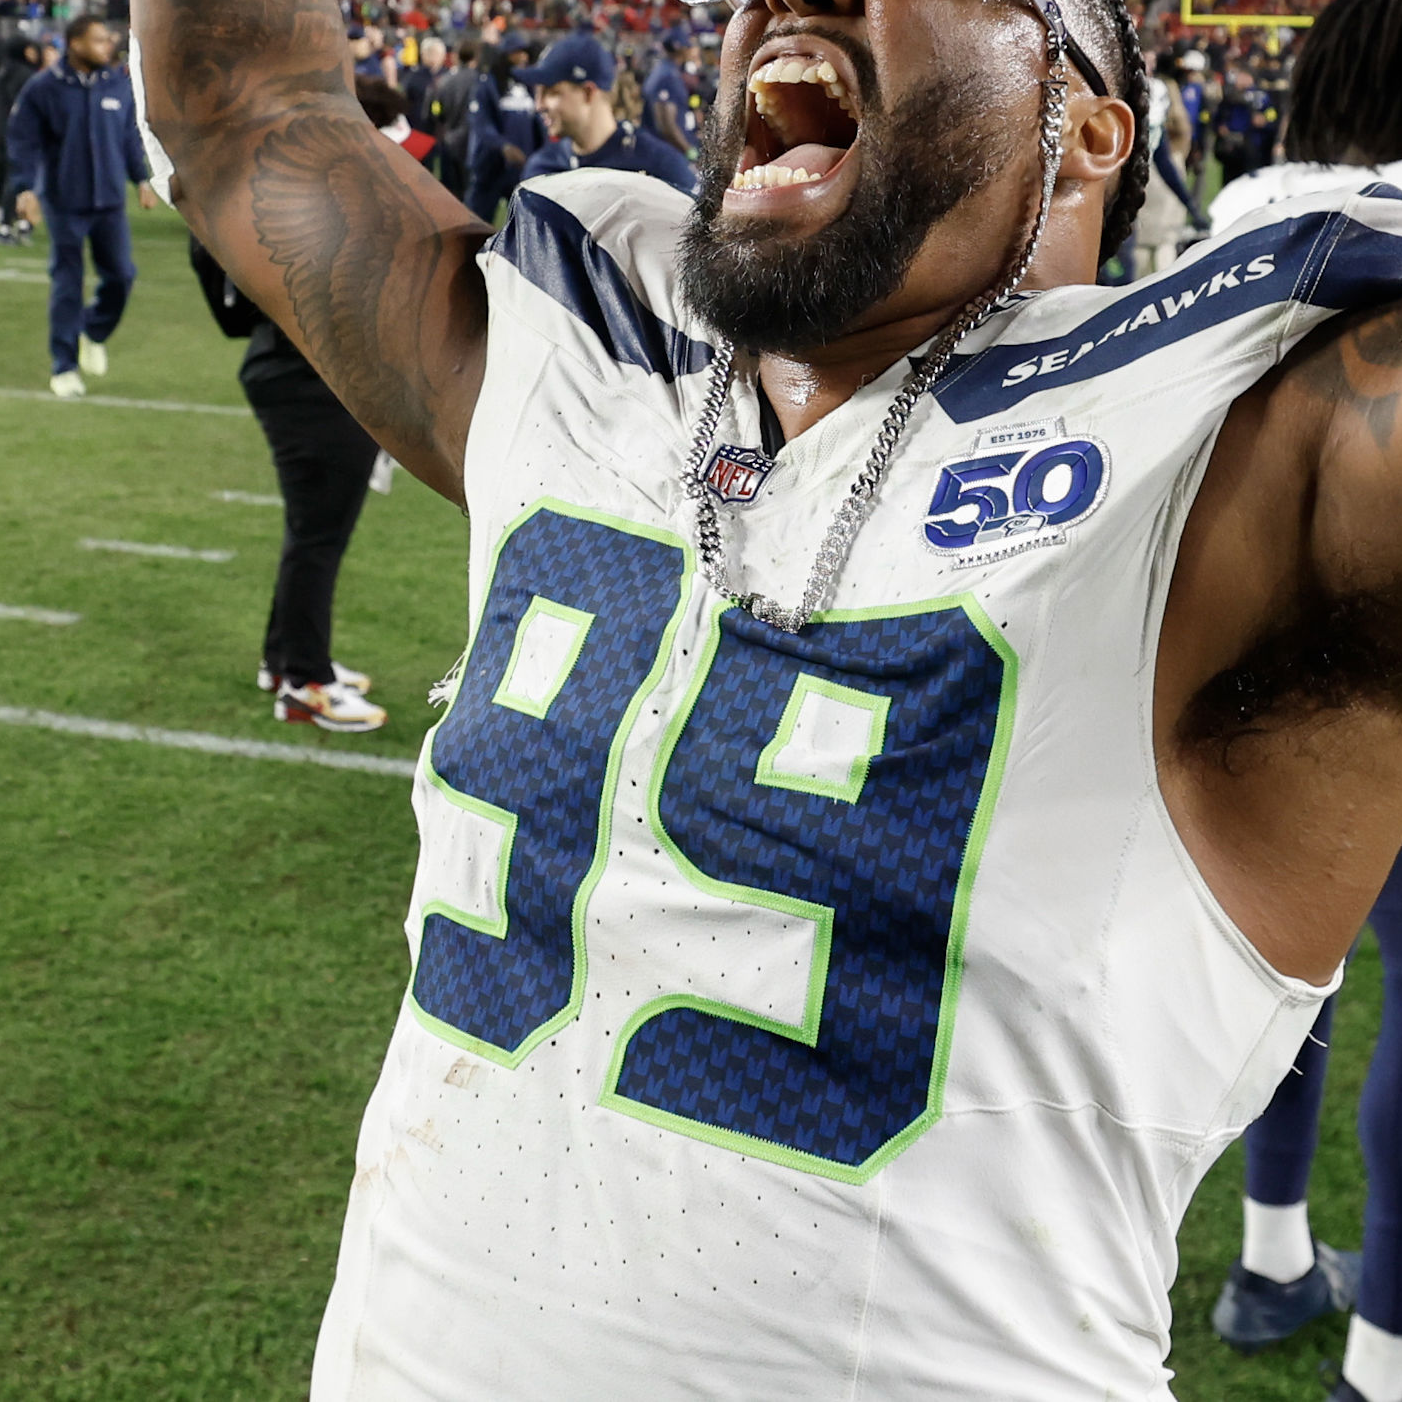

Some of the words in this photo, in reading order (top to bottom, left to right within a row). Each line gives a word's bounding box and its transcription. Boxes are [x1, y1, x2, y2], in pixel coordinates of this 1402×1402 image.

[991, 433, 1014, 444] EST
[1017, 428, 1046, 440] 1976
[708, 459, 756, 496] NFL
[924, 440, 1105, 549] 50
[407, 495, 1019, 1185] 99
